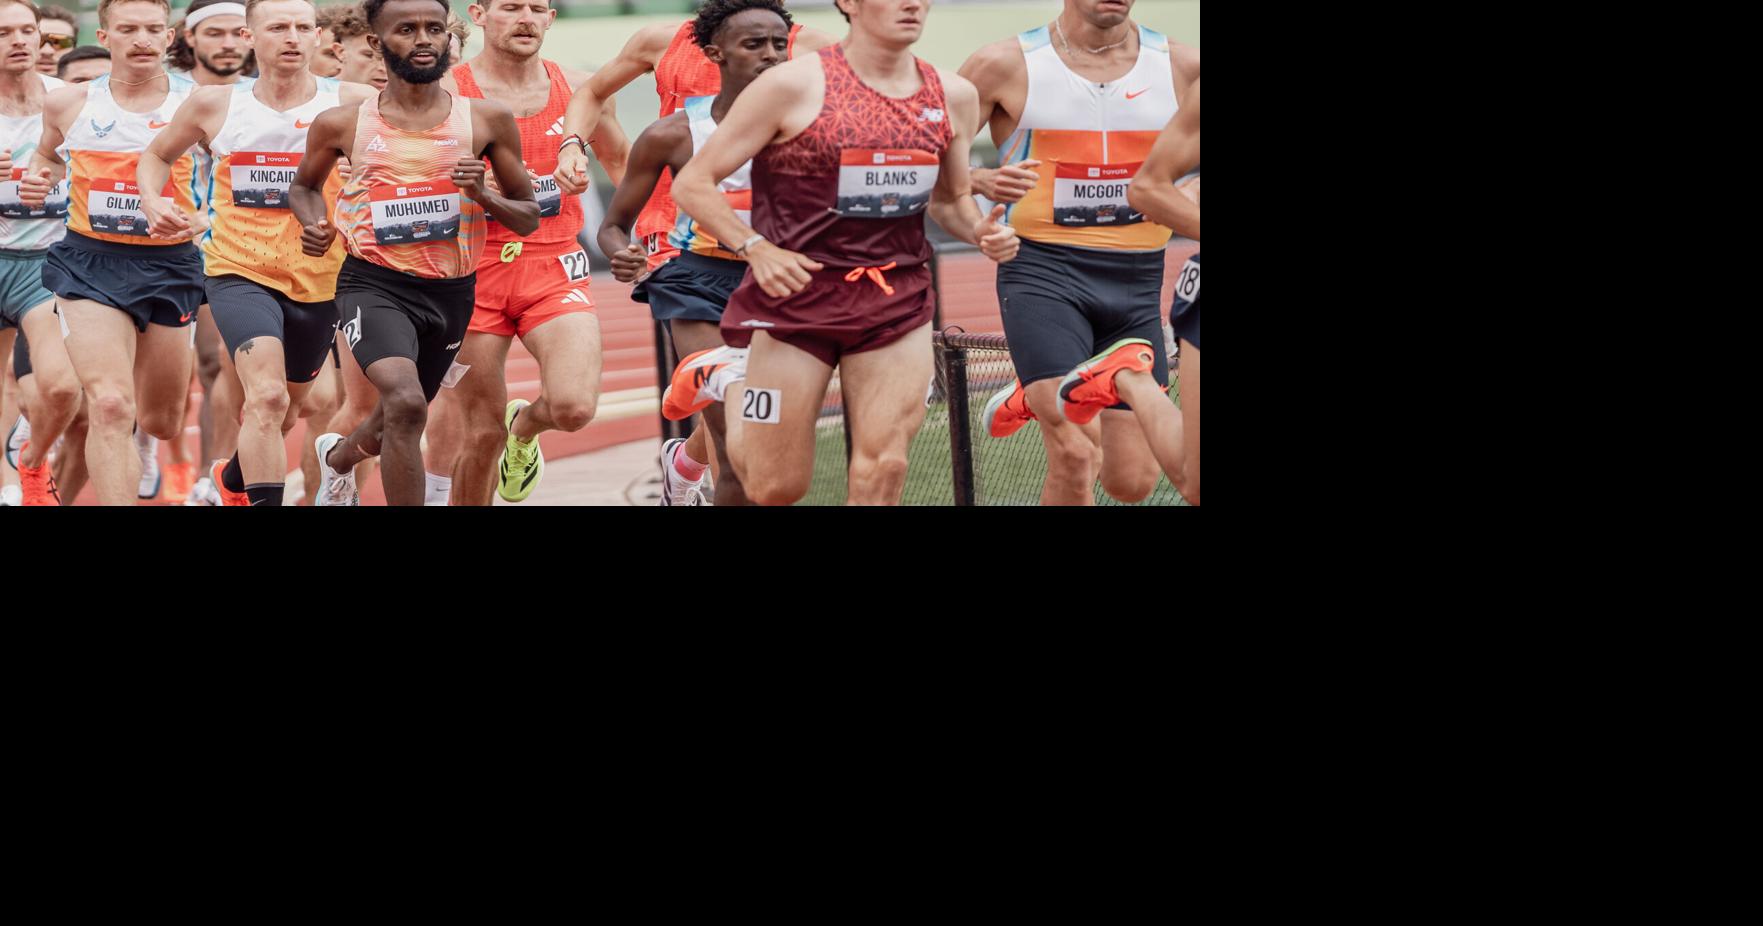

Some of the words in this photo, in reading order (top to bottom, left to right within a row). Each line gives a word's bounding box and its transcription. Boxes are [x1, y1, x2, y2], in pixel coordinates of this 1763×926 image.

[865, 171, 918, 186] BLANKS
[385, 199, 450, 218] MUHUMED
[564, 251, 589, 281] 22
[1179, 265, 1200, 296] 18
[743, 389, 772, 420] 20
